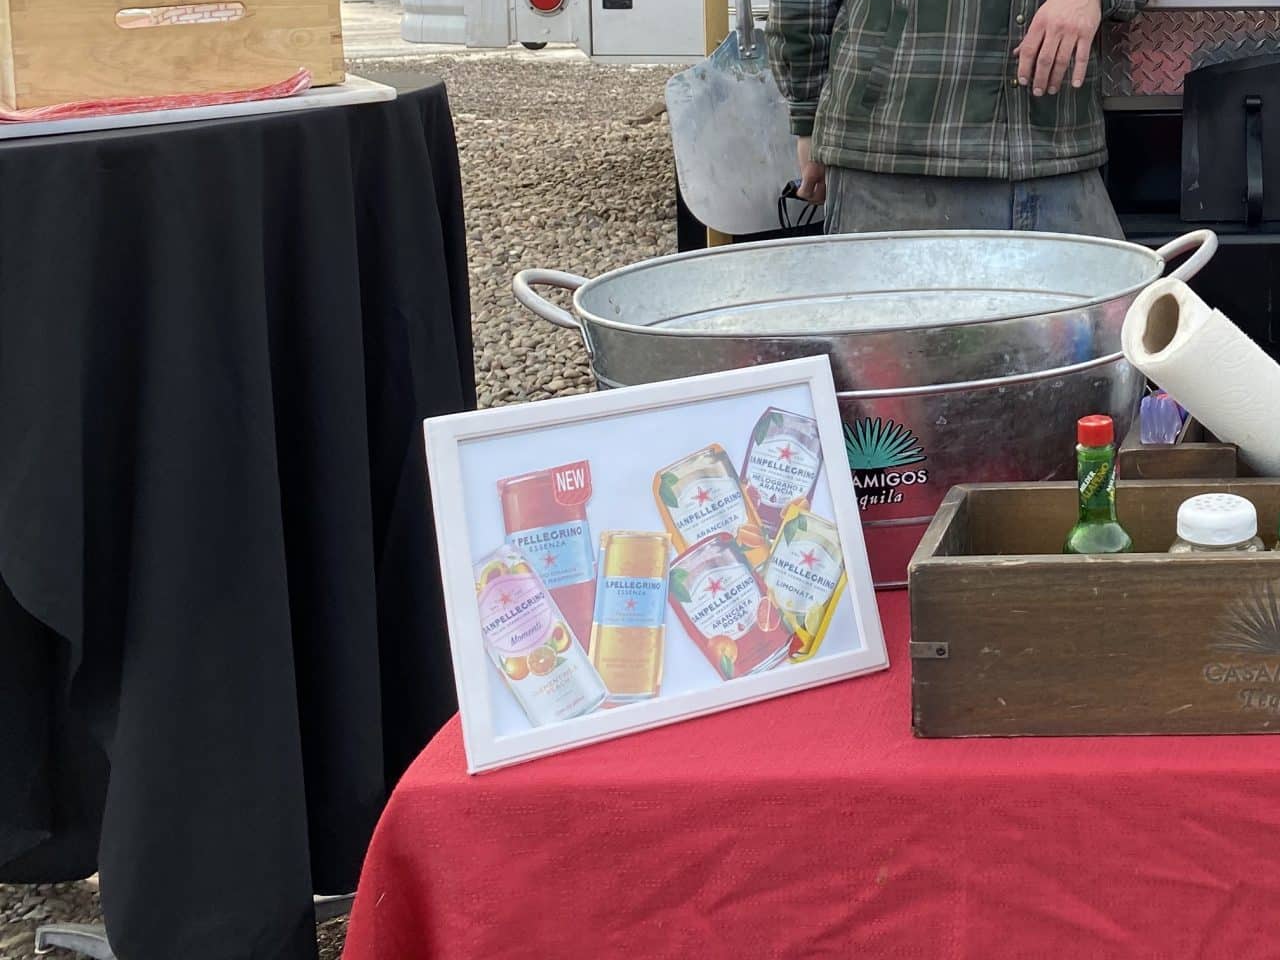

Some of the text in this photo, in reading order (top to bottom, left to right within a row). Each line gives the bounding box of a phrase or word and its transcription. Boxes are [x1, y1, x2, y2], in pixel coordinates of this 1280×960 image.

[555, 468, 585, 492] NEW
[857, 488, 903, 510] quila
[513, 525, 582, 548] PELLEGRINO
[696, 514, 739, 539] ARANCIATA
[529, 540, 567, 553] ESSENZA
[776, 579, 814, 601] LIMONATA
[712, 599, 753, 629] ARANCIATA
[722, 610, 747, 629] ROSSA
[510, 622, 543, 647] Momenti
